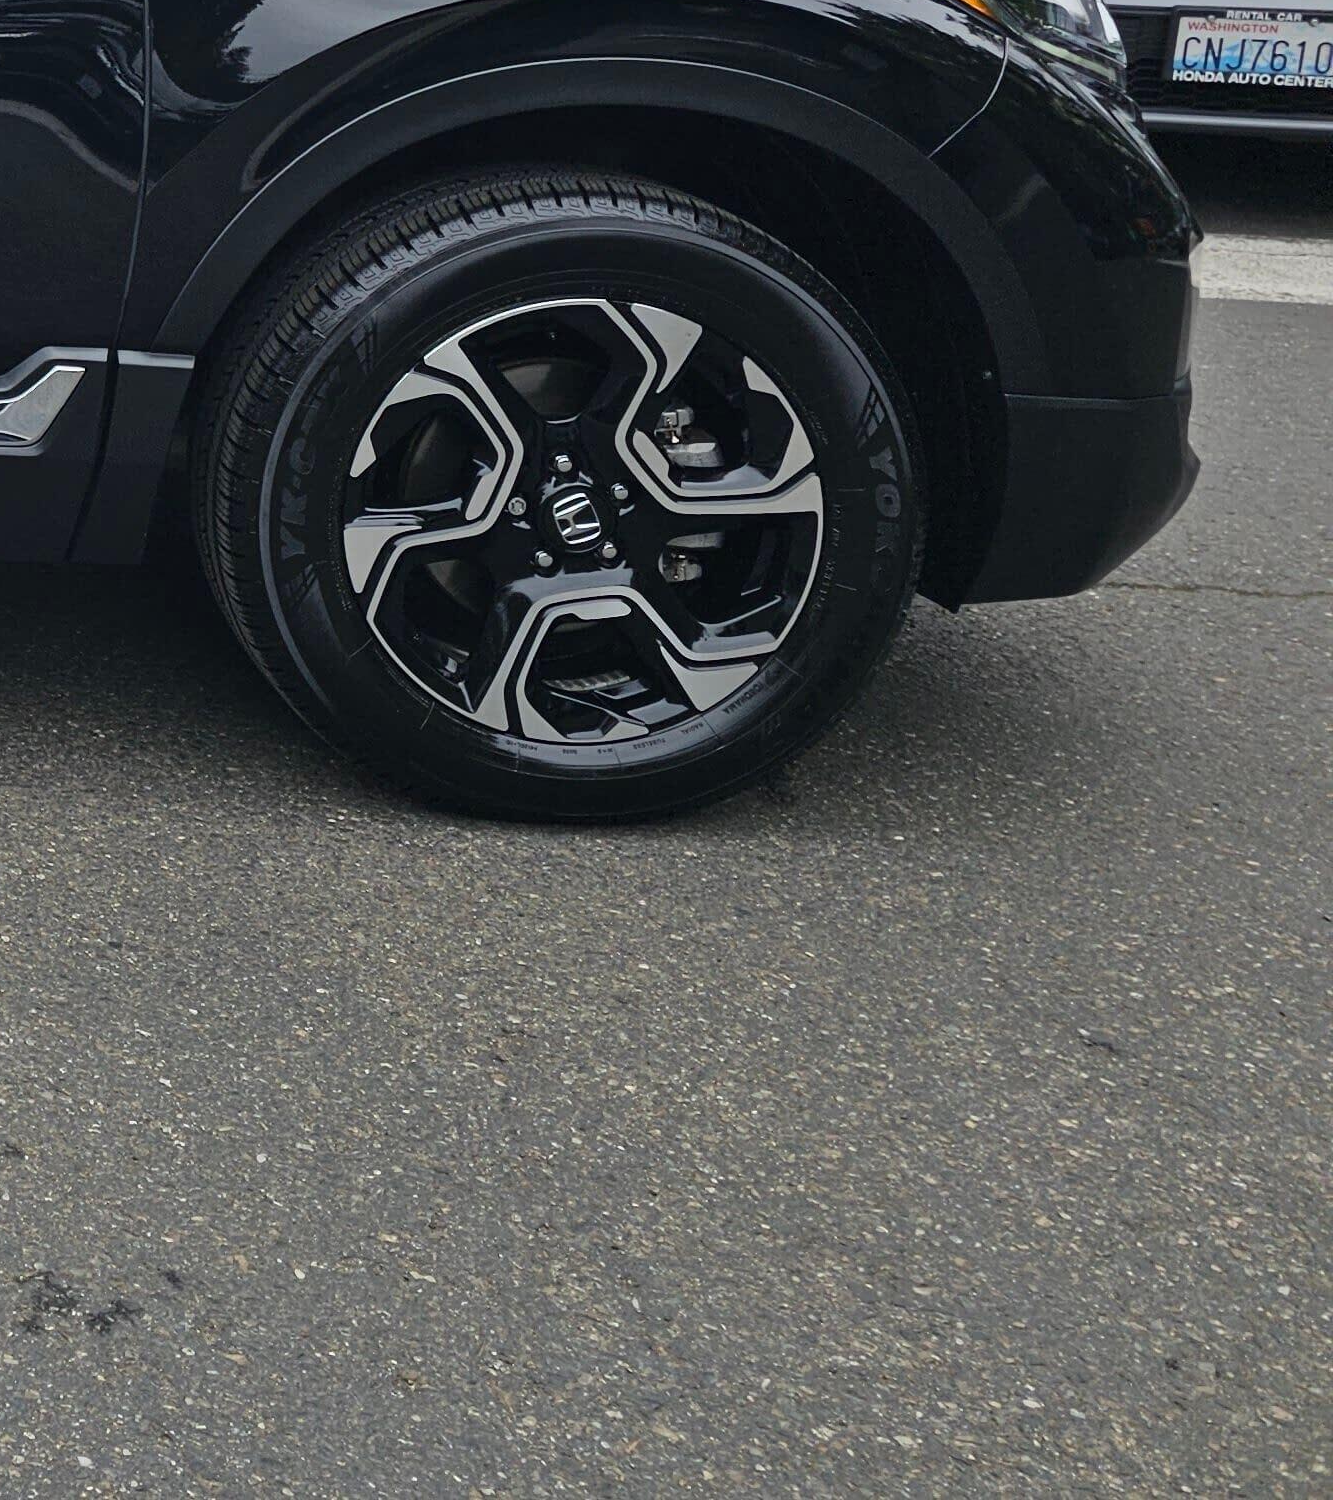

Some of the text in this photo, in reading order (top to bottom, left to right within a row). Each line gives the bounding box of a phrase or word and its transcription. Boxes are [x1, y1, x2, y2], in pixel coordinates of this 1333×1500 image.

[1226, 10, 1303, 22] RENTAL CAR
[1188, 21, 1280, 34] WASHINGTON
[1182, 36, 1333, 74] CNJ7610
[1172, 70, 1333, 88] HONDA AUTO CENTER
